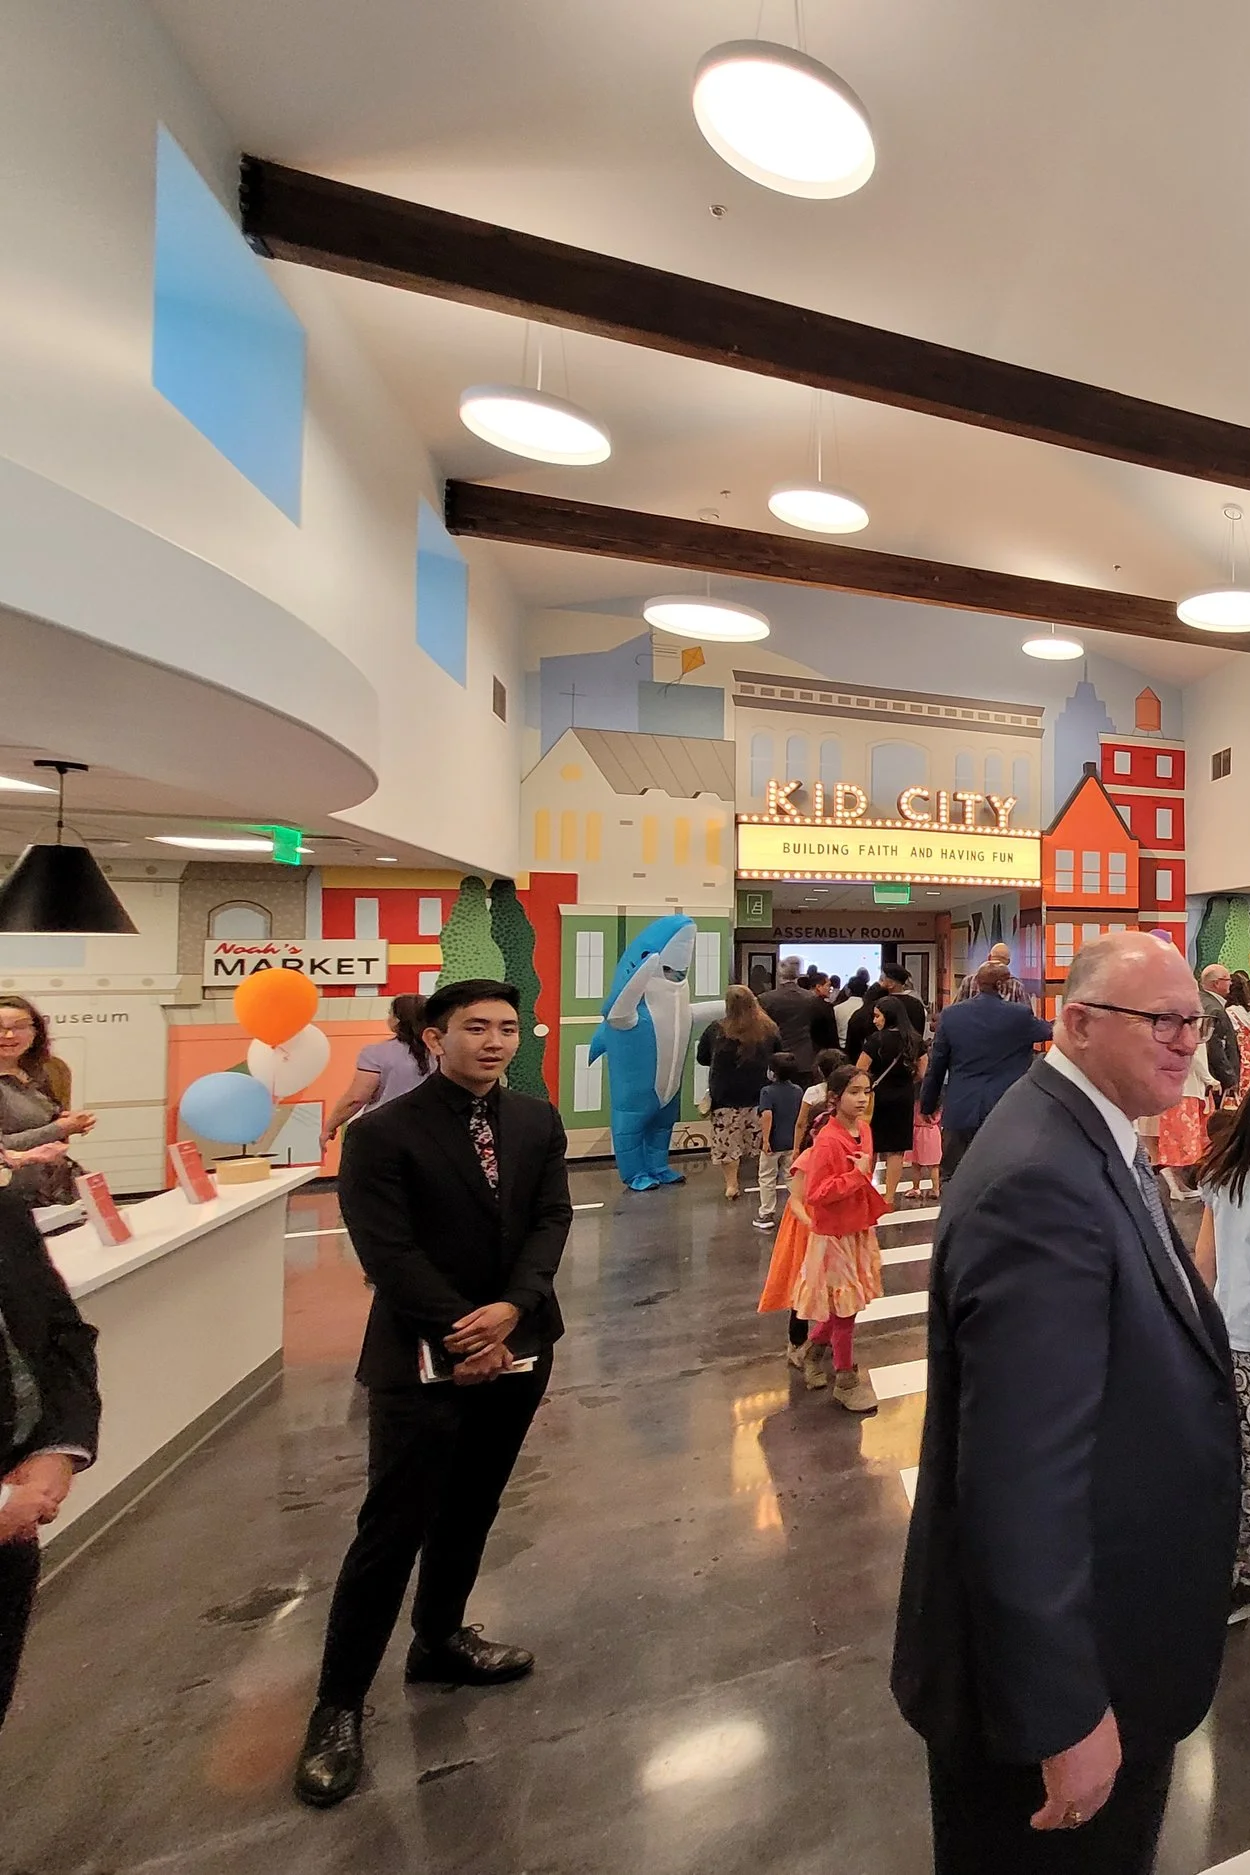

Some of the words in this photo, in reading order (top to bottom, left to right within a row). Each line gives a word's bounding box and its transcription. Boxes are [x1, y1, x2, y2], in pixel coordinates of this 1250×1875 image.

[767, 779, 868, 818] KID
[896, 786, 1017, 827] CITY
[783, 842, 849, 856] BUILDING
[858, 844, 898, 857] FAITH
[910, 846, 933, 859] AND
[941, 848, 985, 862] HAVING
[992, 851, 1014, 863] FUN
[773, 927, 856, 938] ASSEMBLY
[861, 927, 905, 938] ROOM
[213, 942, 303, 955] Noah's
